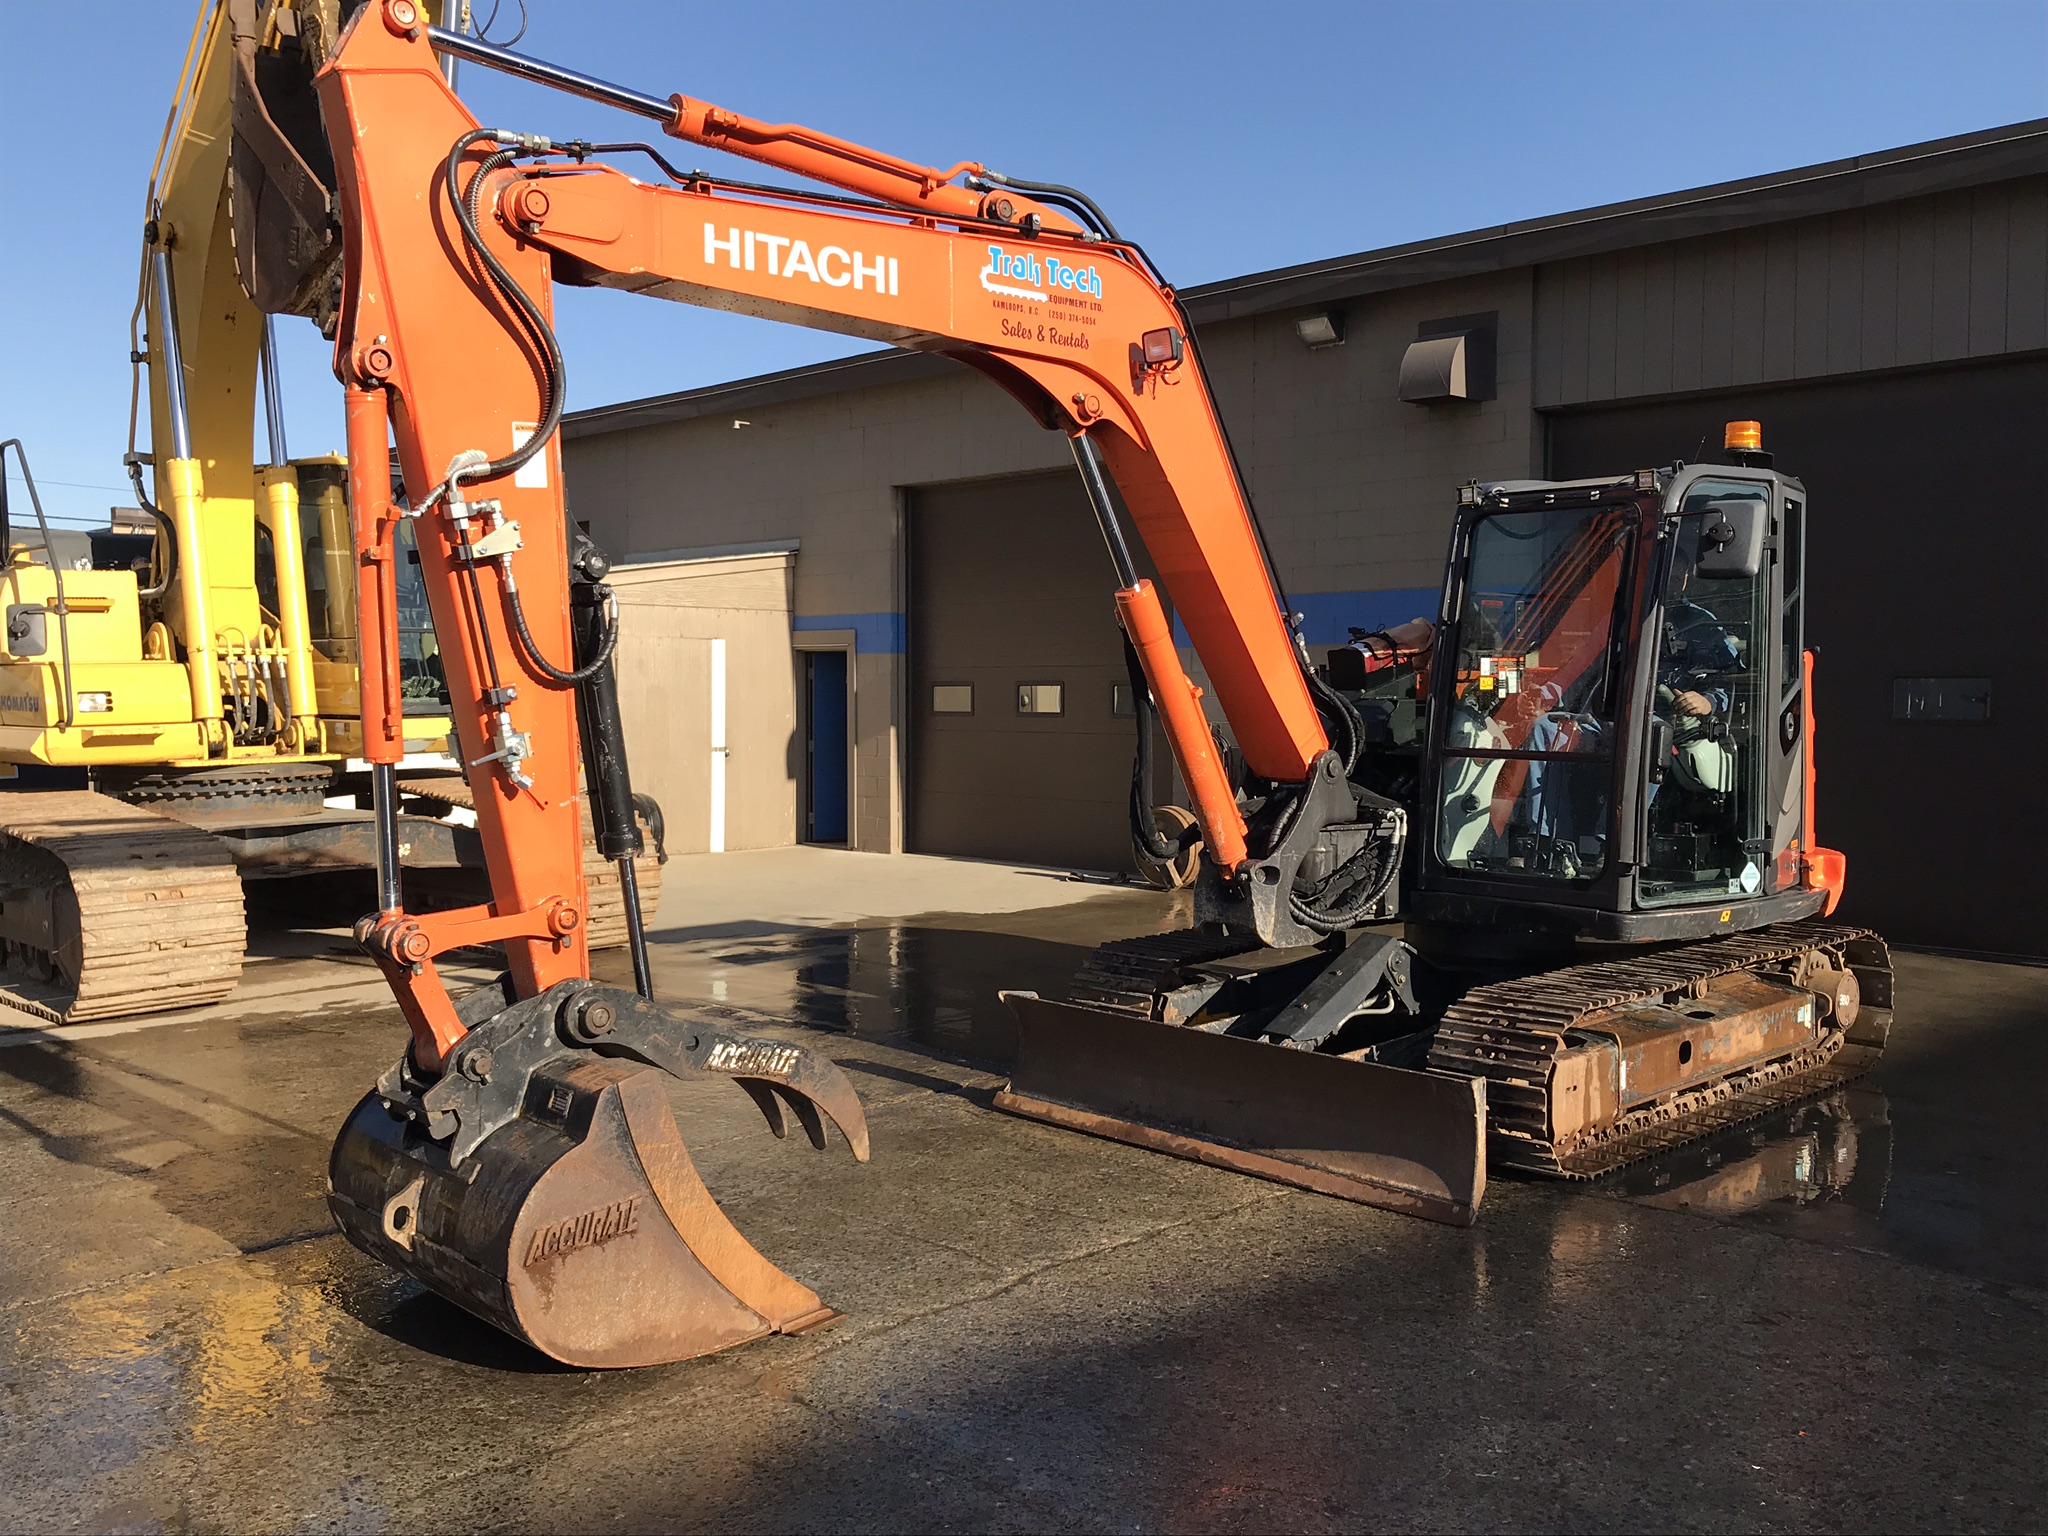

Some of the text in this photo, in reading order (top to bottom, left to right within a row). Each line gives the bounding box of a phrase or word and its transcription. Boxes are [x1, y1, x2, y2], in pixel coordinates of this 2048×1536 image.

[703, 222, 899, 297] HITACHI
[987, 244, 1102, 299] Trak Tech
[992, 299, 1026, 314] KAMLOOPS,
[1048, 309, 1067, 321] (250)
[1068, 313, 1097, 326] 374-5054
[1049, 294, 1104, 313] EQUIPMENT LTD.
[1001, 318, 1090, 350] Sales & Rentals
[0, 692, 39, 712] KOMATSU
[701, 1040, 800, 1076] ACCURATE
[523, 1198, 642, 1268] ACCURATE
